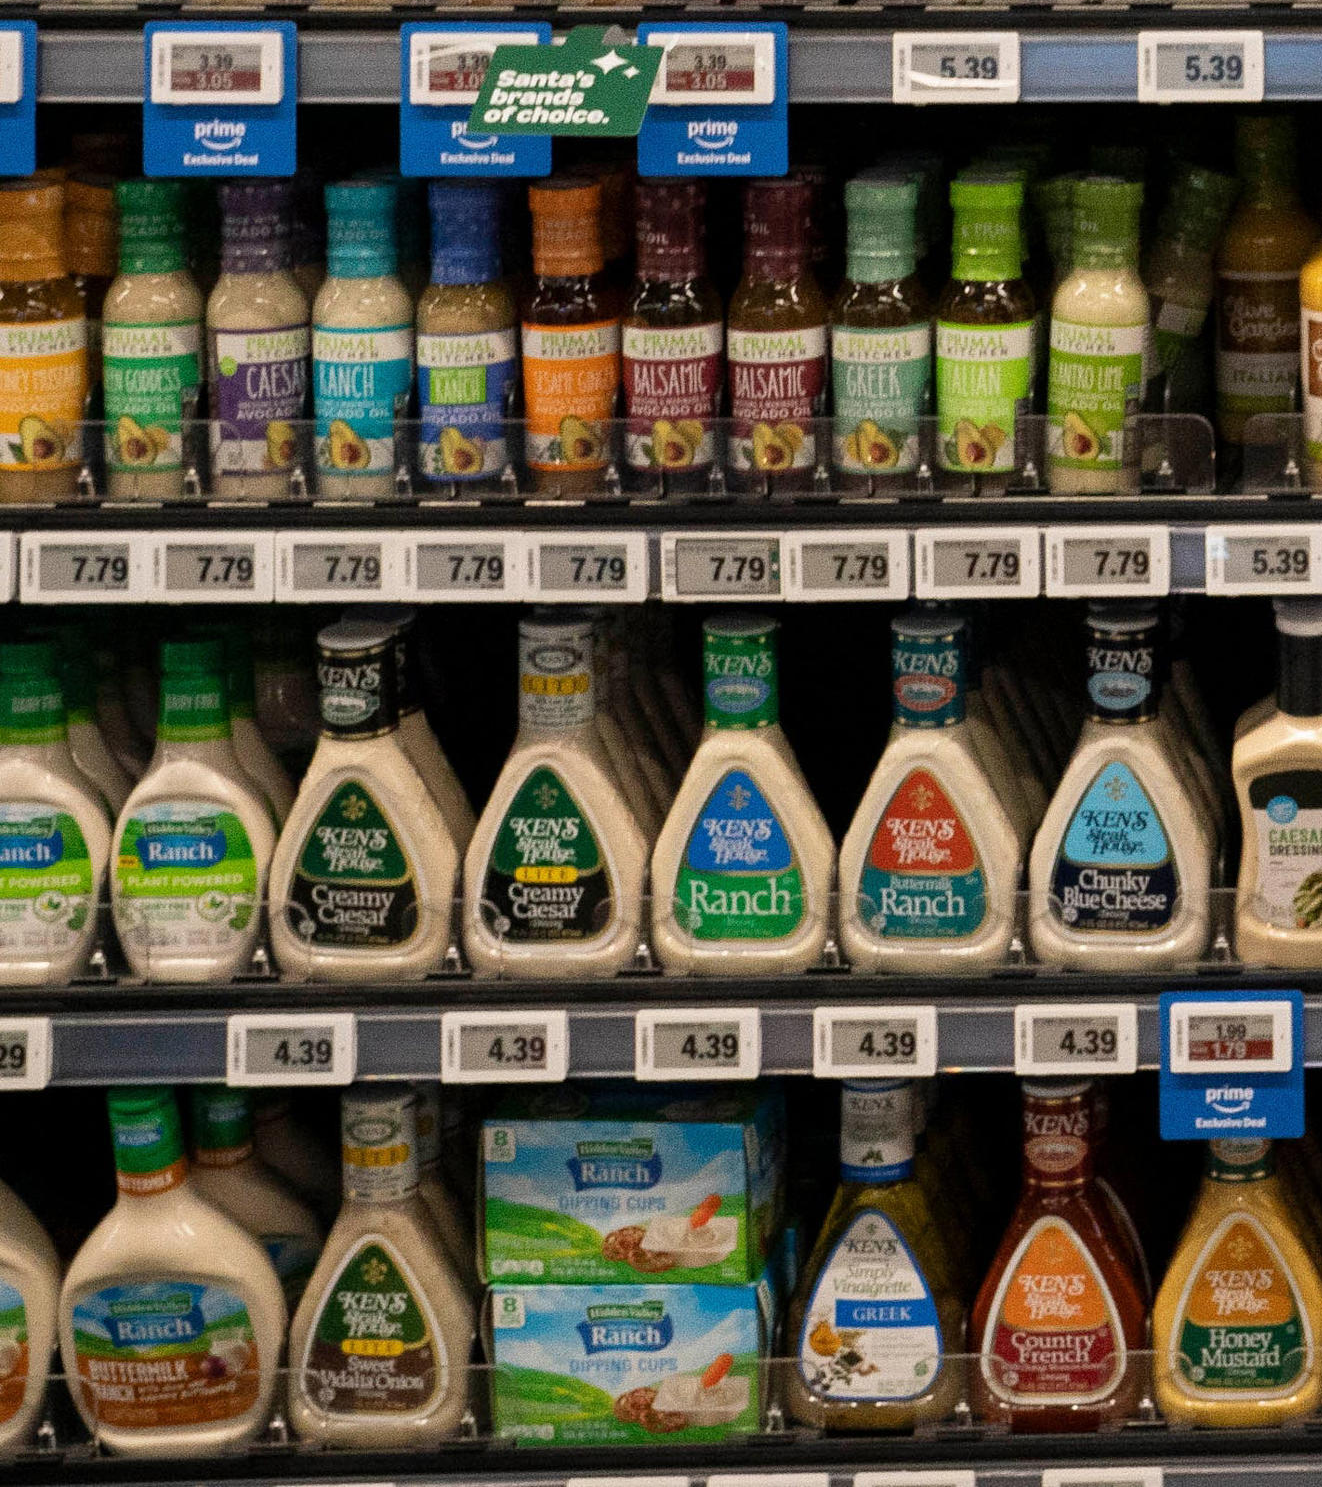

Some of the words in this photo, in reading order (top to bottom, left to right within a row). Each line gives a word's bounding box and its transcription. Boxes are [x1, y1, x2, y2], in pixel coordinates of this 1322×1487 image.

[496, 70, 594, 89] Santa's
[1185, 55, 1242, 81] 5.39
[490, 90, 585, 106] brands
[484, 106, 506, 124] of
[510, 105, 610, 124] choice.
[634, 363, 707, 397] BALSAMIC
[846, 365, 899, 397] GREEK
[73, 557, 129, 582] 7.79
[325, 556, 380, 582] 7.79
[570, 557, 626, 582] 7.79
[832, 555, 887, 580] 7.79
[1094, 550, 1149, 576] 7.79
[1253, 549, 1310, 575] 5.39
[706, 651, 771, 677] KEN'S
[316, 827, 388, 849] KEN'S
[511, 817, 579, 838] KEN'S
[705, 817, 772, 839] KEN'S
[887, 817, 956, 839] KEN'S
[148, 840, 215, 863] Ranch
[1079, 870, 1150, 896] Chunky
[312, 884, 394, 912] Creamy
[690, 879, 791, 915] Ranch
[1064, 889, 1099, 910] Blue
[1101, 889, 1167, 911] Cheese
[321, 904, 387, 927] Caesar
[274, 1040, 332, 1065] 4.39
[680, 1033, 739, 1058] 4.39
[1059, 1029, 1116, 1054] 4.39
[559, 1195, 620, 1210] DIPPING
[627, 1196, 666, 1210] CUPS
[853, 1307, 911, 1321] GREEK
[1011, 1332, 1095, 1356] Country
[1209, 1329, 1272, 1353] Honey
[1202, 1348, 1280, 1368] Mustard
